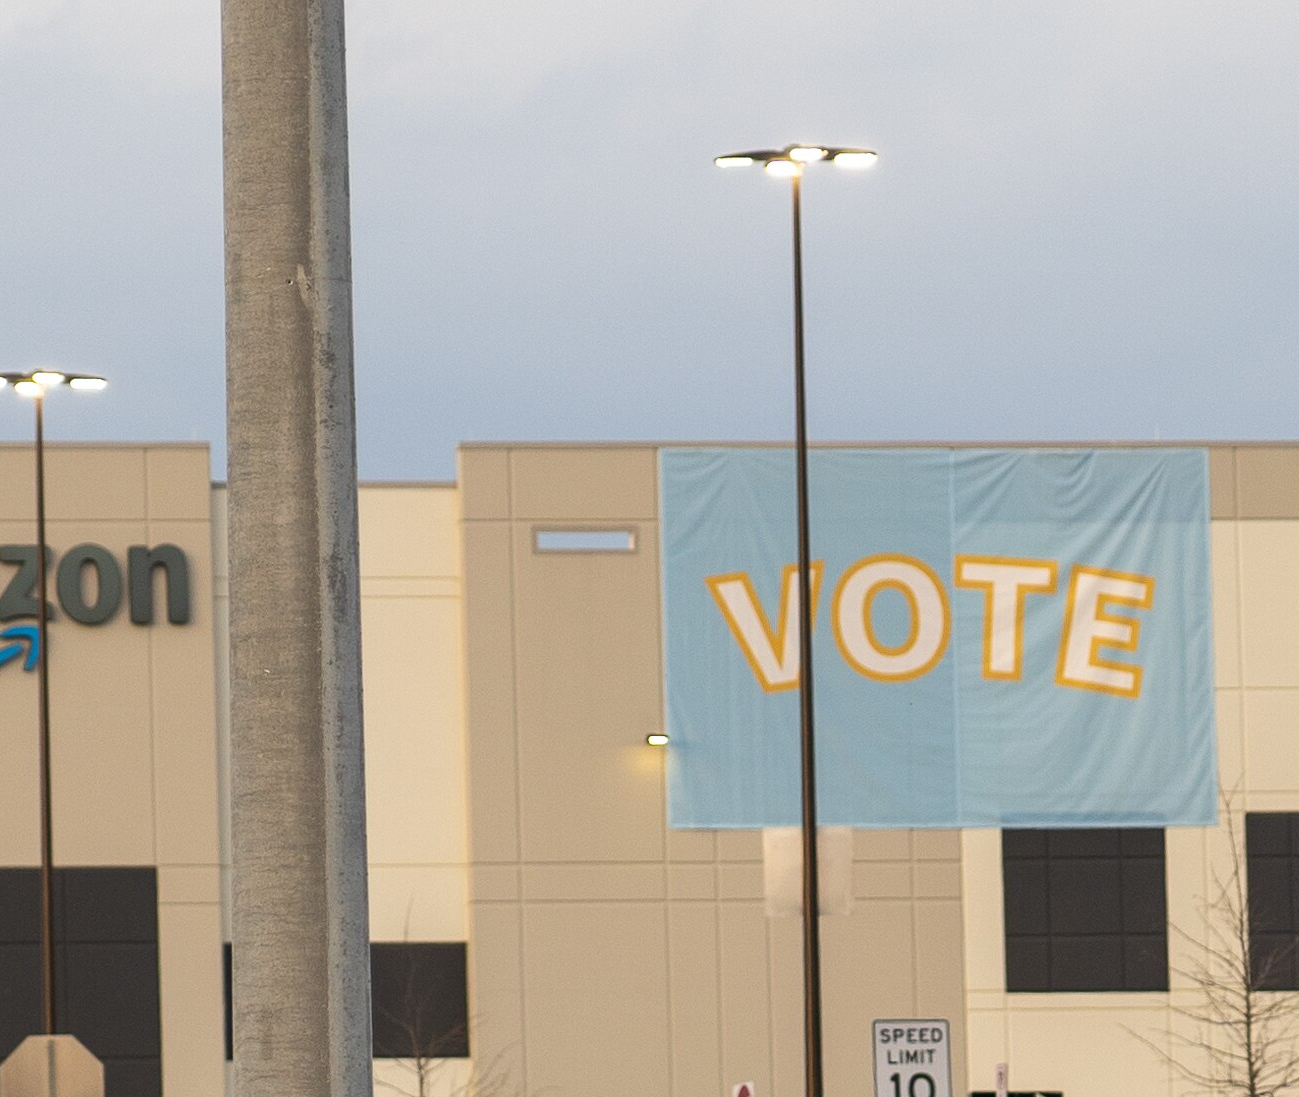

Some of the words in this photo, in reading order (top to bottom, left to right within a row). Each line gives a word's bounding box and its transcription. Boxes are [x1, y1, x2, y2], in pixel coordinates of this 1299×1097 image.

[704, 552, 1156, 699] VOTE
[880, 1028, 943, 1044] SPEED
[887, 1049, 937, 1065] LIMIT
